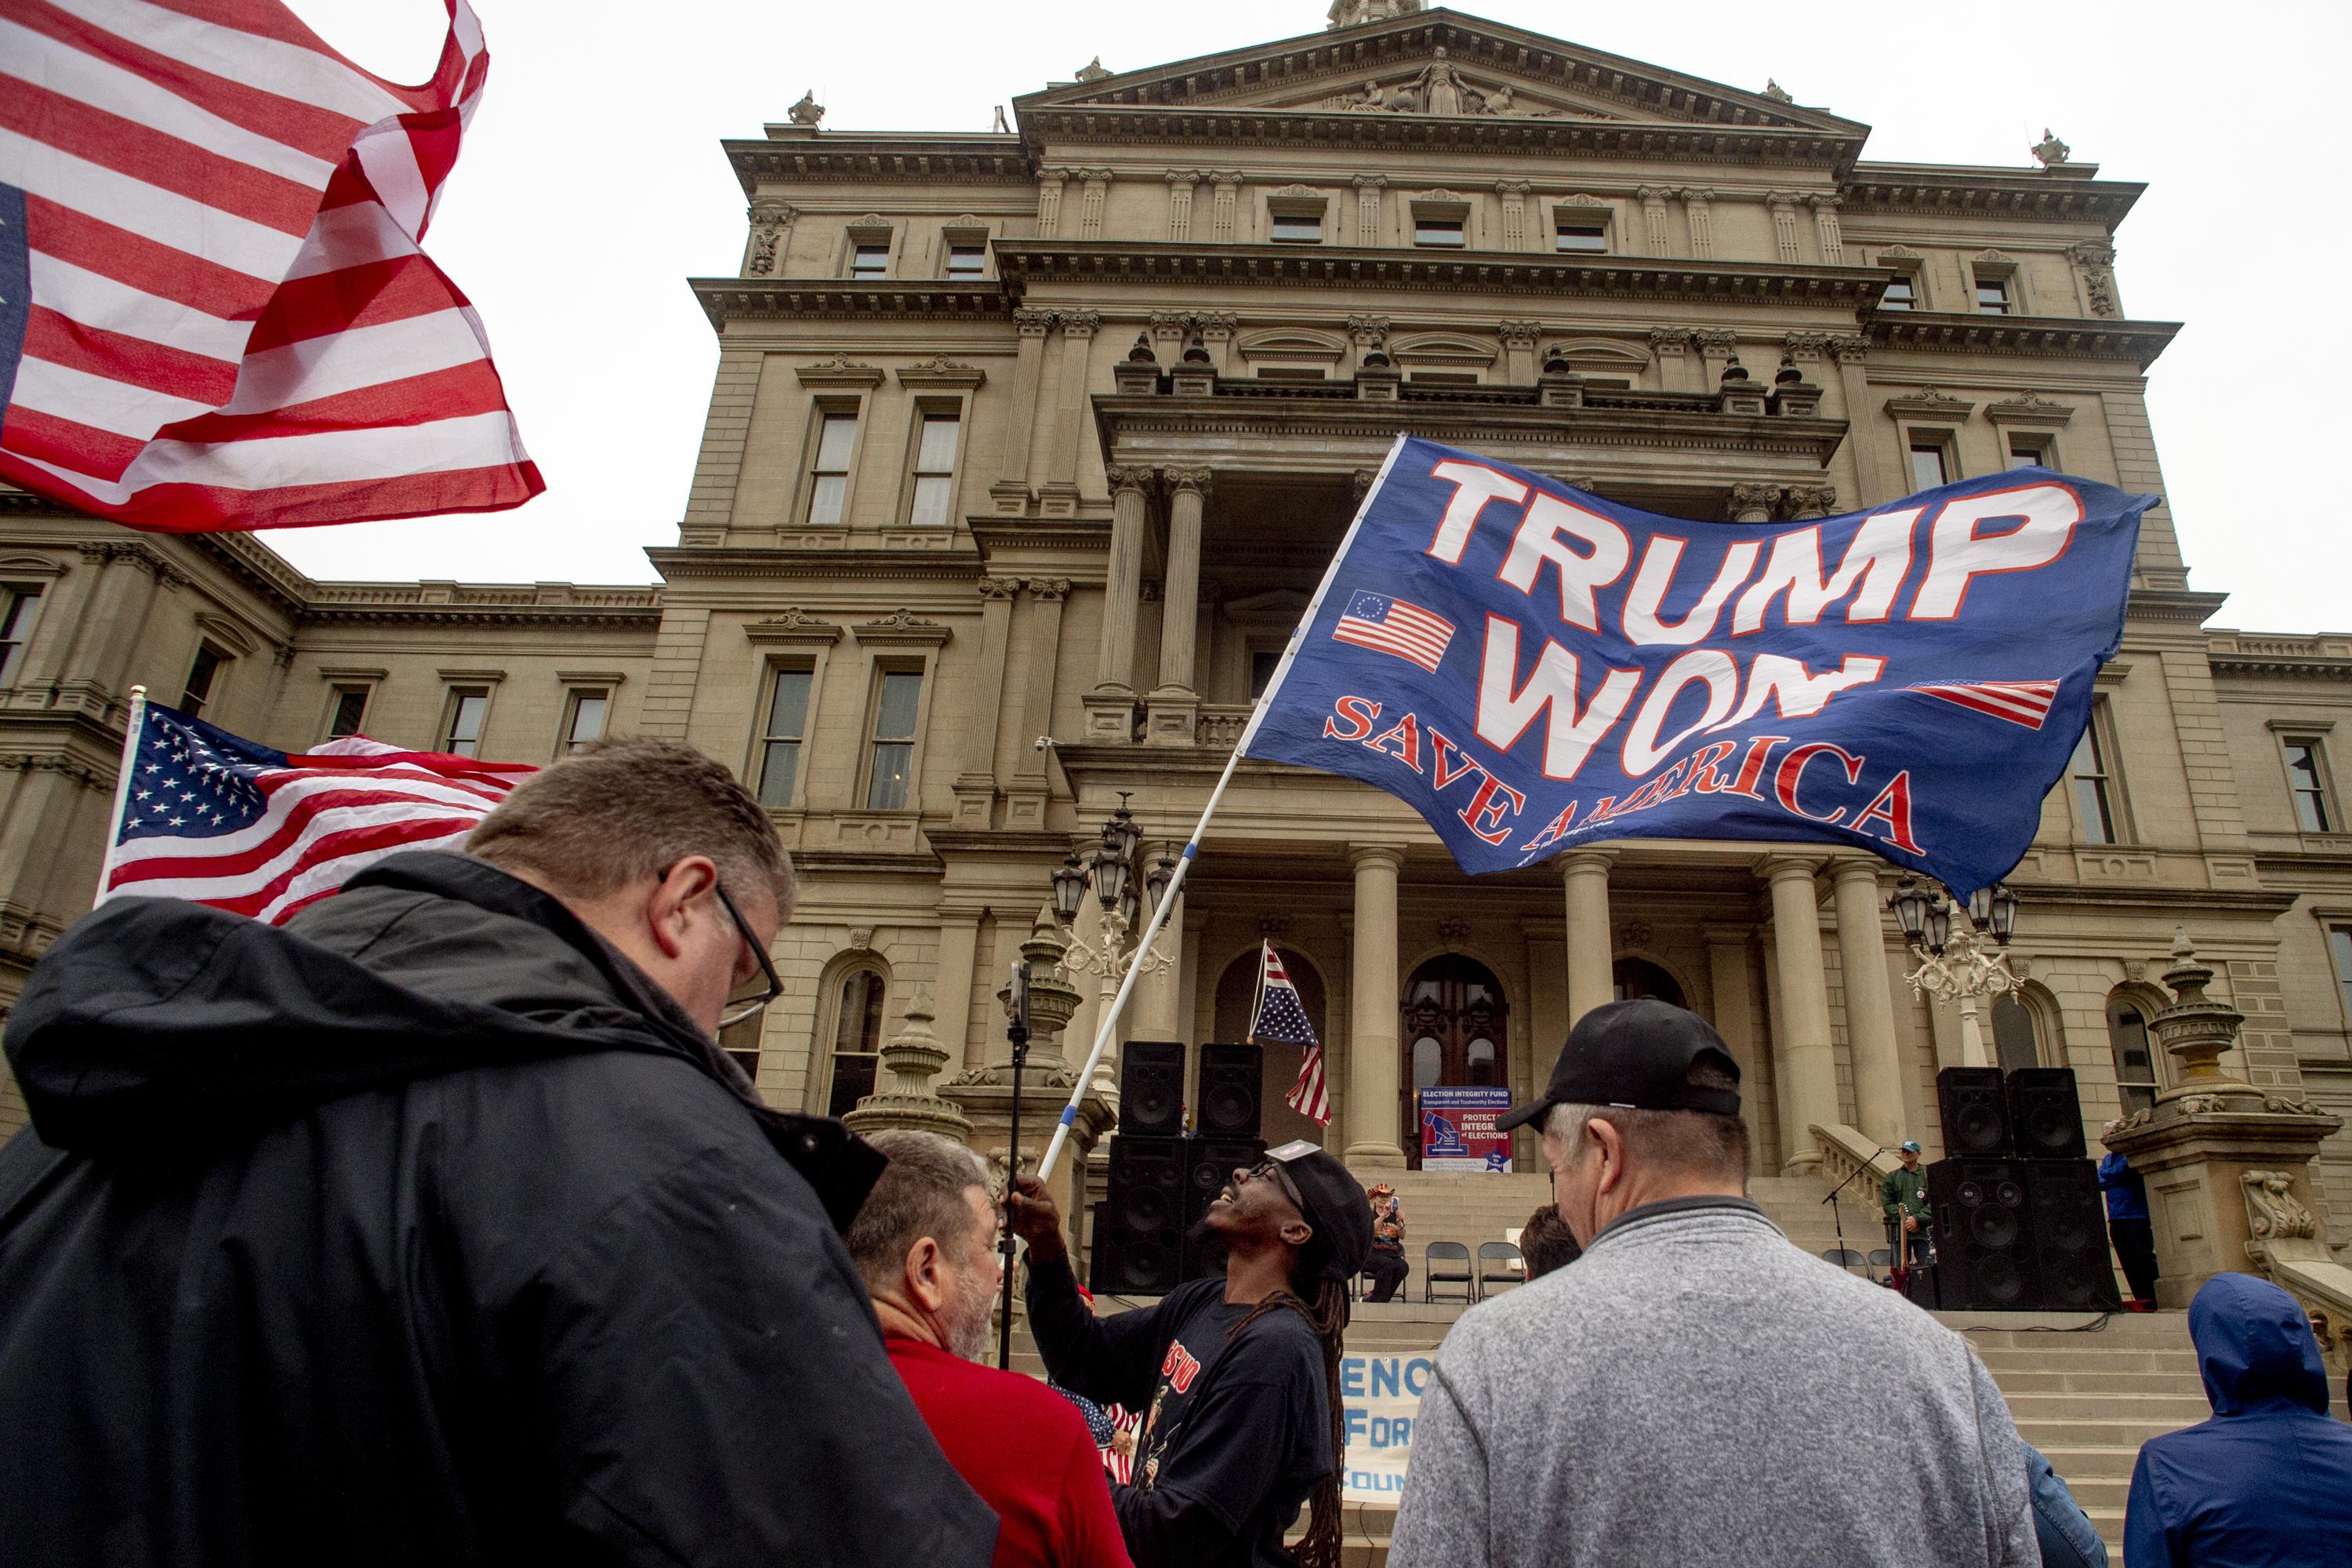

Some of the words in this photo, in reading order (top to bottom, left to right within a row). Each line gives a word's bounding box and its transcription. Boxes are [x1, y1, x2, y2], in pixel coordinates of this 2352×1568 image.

[1425, 458, 2086, 647] TRUMP
[1323, 695, 1526, 847] SAVE
[1474, 612, 1889, 782] WON
